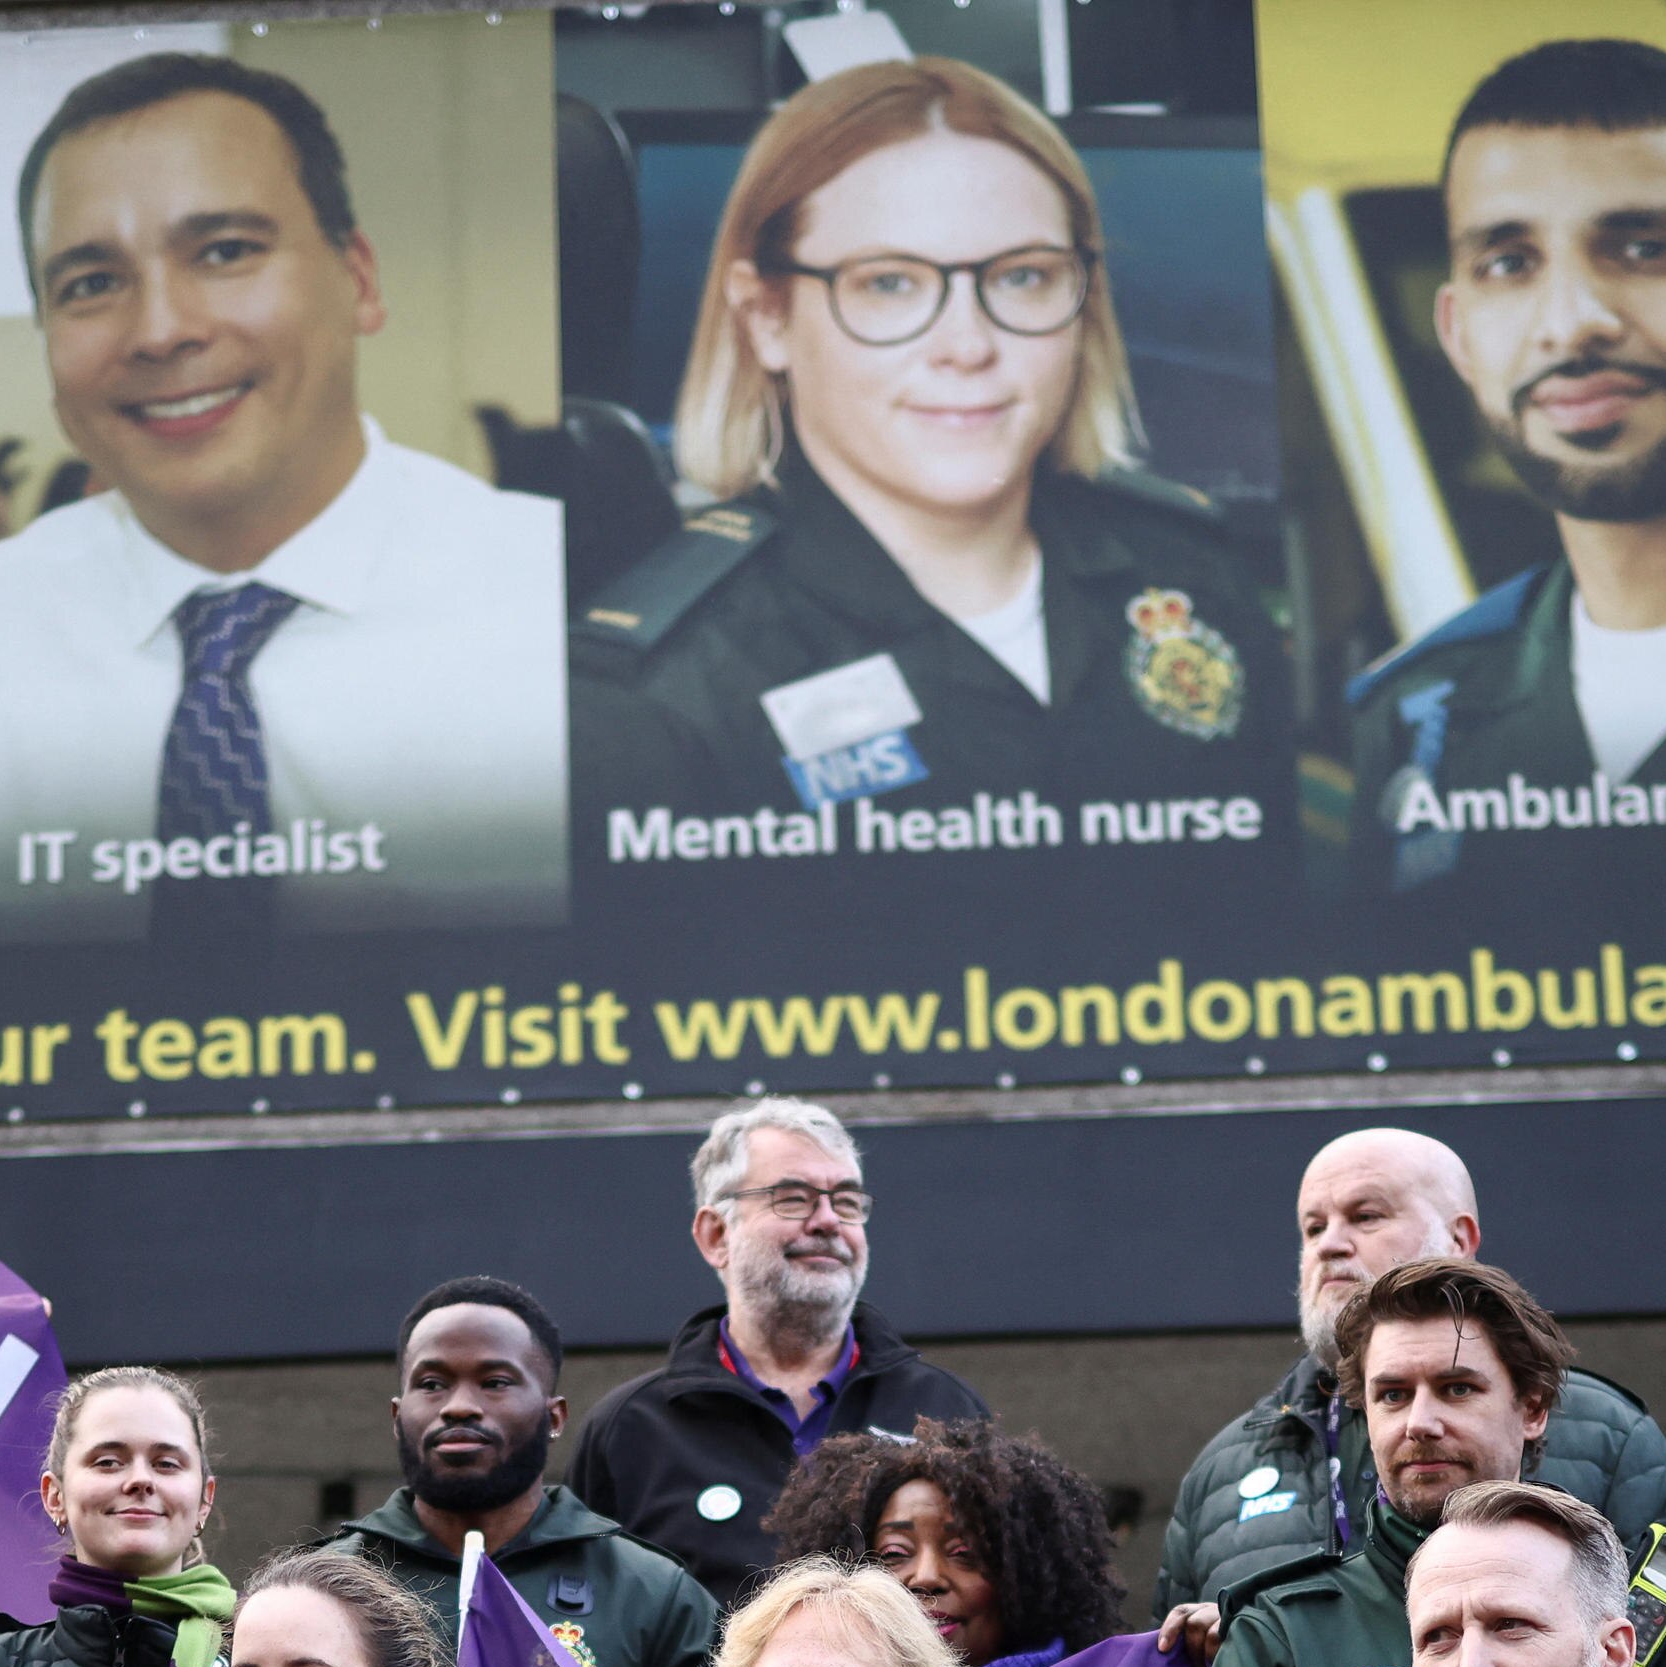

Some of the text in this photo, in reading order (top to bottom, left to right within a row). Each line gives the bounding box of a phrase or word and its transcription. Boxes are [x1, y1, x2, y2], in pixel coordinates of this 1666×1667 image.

[803, 733, 910, 796] NHS
[18, 819, 387, 893] IT specialist
[607, 793, 1263, 862] Mental health nurse
[98, 1012, 374, 1080] team.
[409, 984, 629, 1069] Visit
